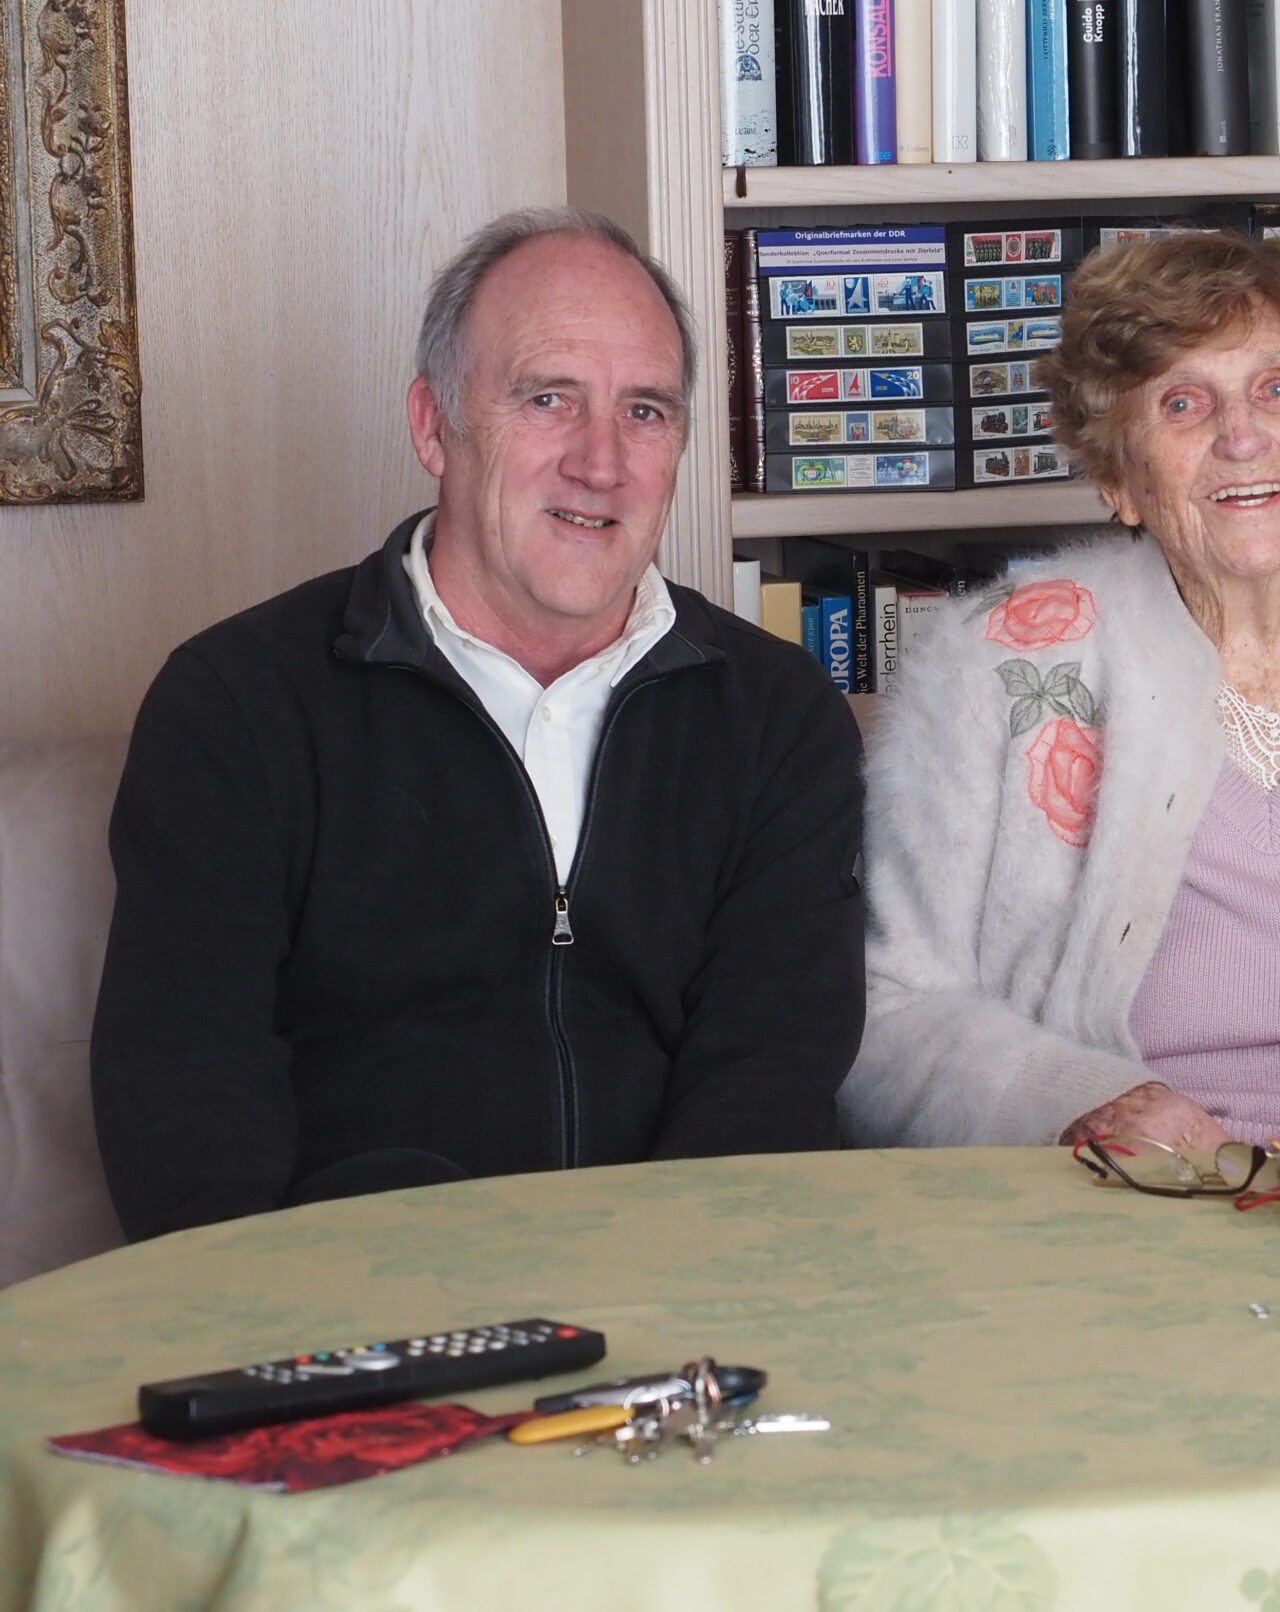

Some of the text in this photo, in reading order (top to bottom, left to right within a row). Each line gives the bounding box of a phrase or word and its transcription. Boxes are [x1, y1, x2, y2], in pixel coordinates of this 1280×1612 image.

[1083, 7, 1093, 43] Guido
[1094, 4, 1105, 42] Knopp
[1216, 25, 1224, 73] JONATHAN
[795, 229, 906, 240] Originalbriefmarken der DDR
[855, 571, 867, 630] Pharaonen
[957, 579, 967, 596] en
[829, 608, 850, 694] UROPA
[856, 632, 867, 652] der
[878, 602, 898, 694] ederrhein
[856, 652, 868, 682] Welt
